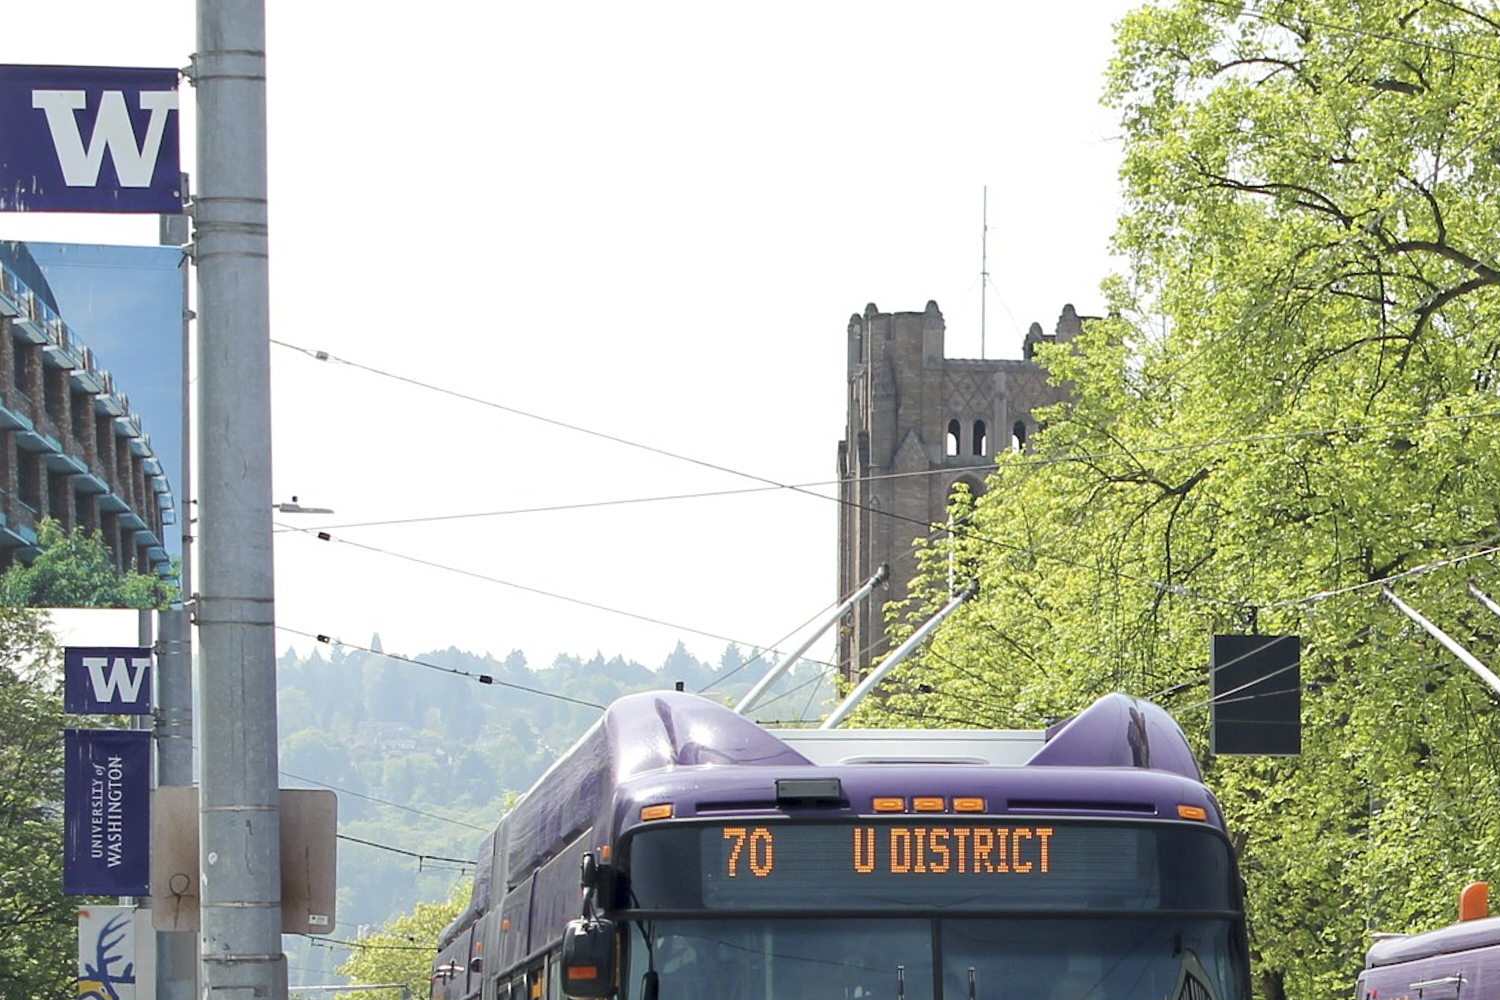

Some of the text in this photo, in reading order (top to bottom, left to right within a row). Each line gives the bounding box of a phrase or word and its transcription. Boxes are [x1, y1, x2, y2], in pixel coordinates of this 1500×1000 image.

[32, 90, 179, 188] W
[83, 657, 150, 702] W
[92, 763, 106, 859] UNIVERSITY of
[107, 756, 122, 868] WASHINGTON
[723, 827, 1053, 877] 70 U DISTRICT
